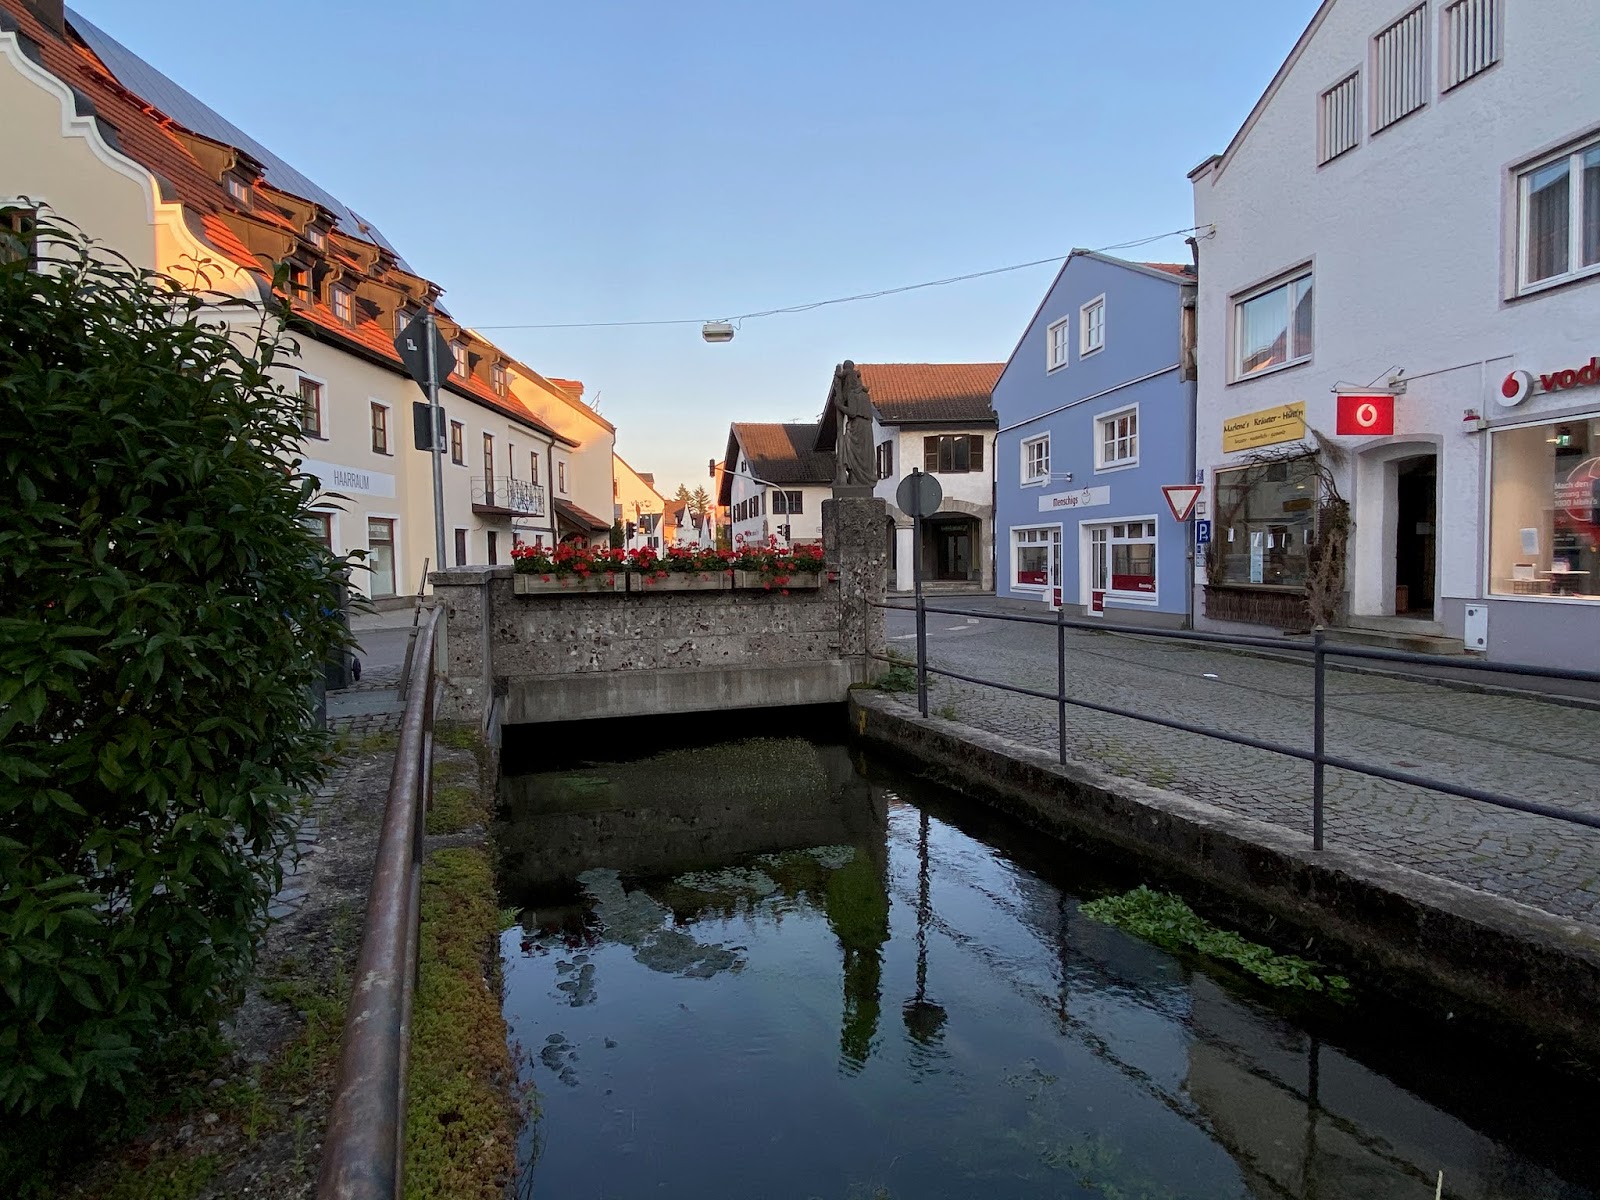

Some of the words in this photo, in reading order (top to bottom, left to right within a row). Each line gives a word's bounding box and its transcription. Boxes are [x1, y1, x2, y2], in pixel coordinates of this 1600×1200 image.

[1540, 357, 1600, 391] vod
[1254, 415, 1277, 426] Kräuter
[333, 469, 369, 490] HAARRAUM
[1574, 480, 1589, 488] den
[1052, 495, 1078, 507] Menschigs
[1554, 491, 1580, 500] Sprung
[1554, 499, 1572, 507] 1000
[1199, 523, 1208, 541] P
